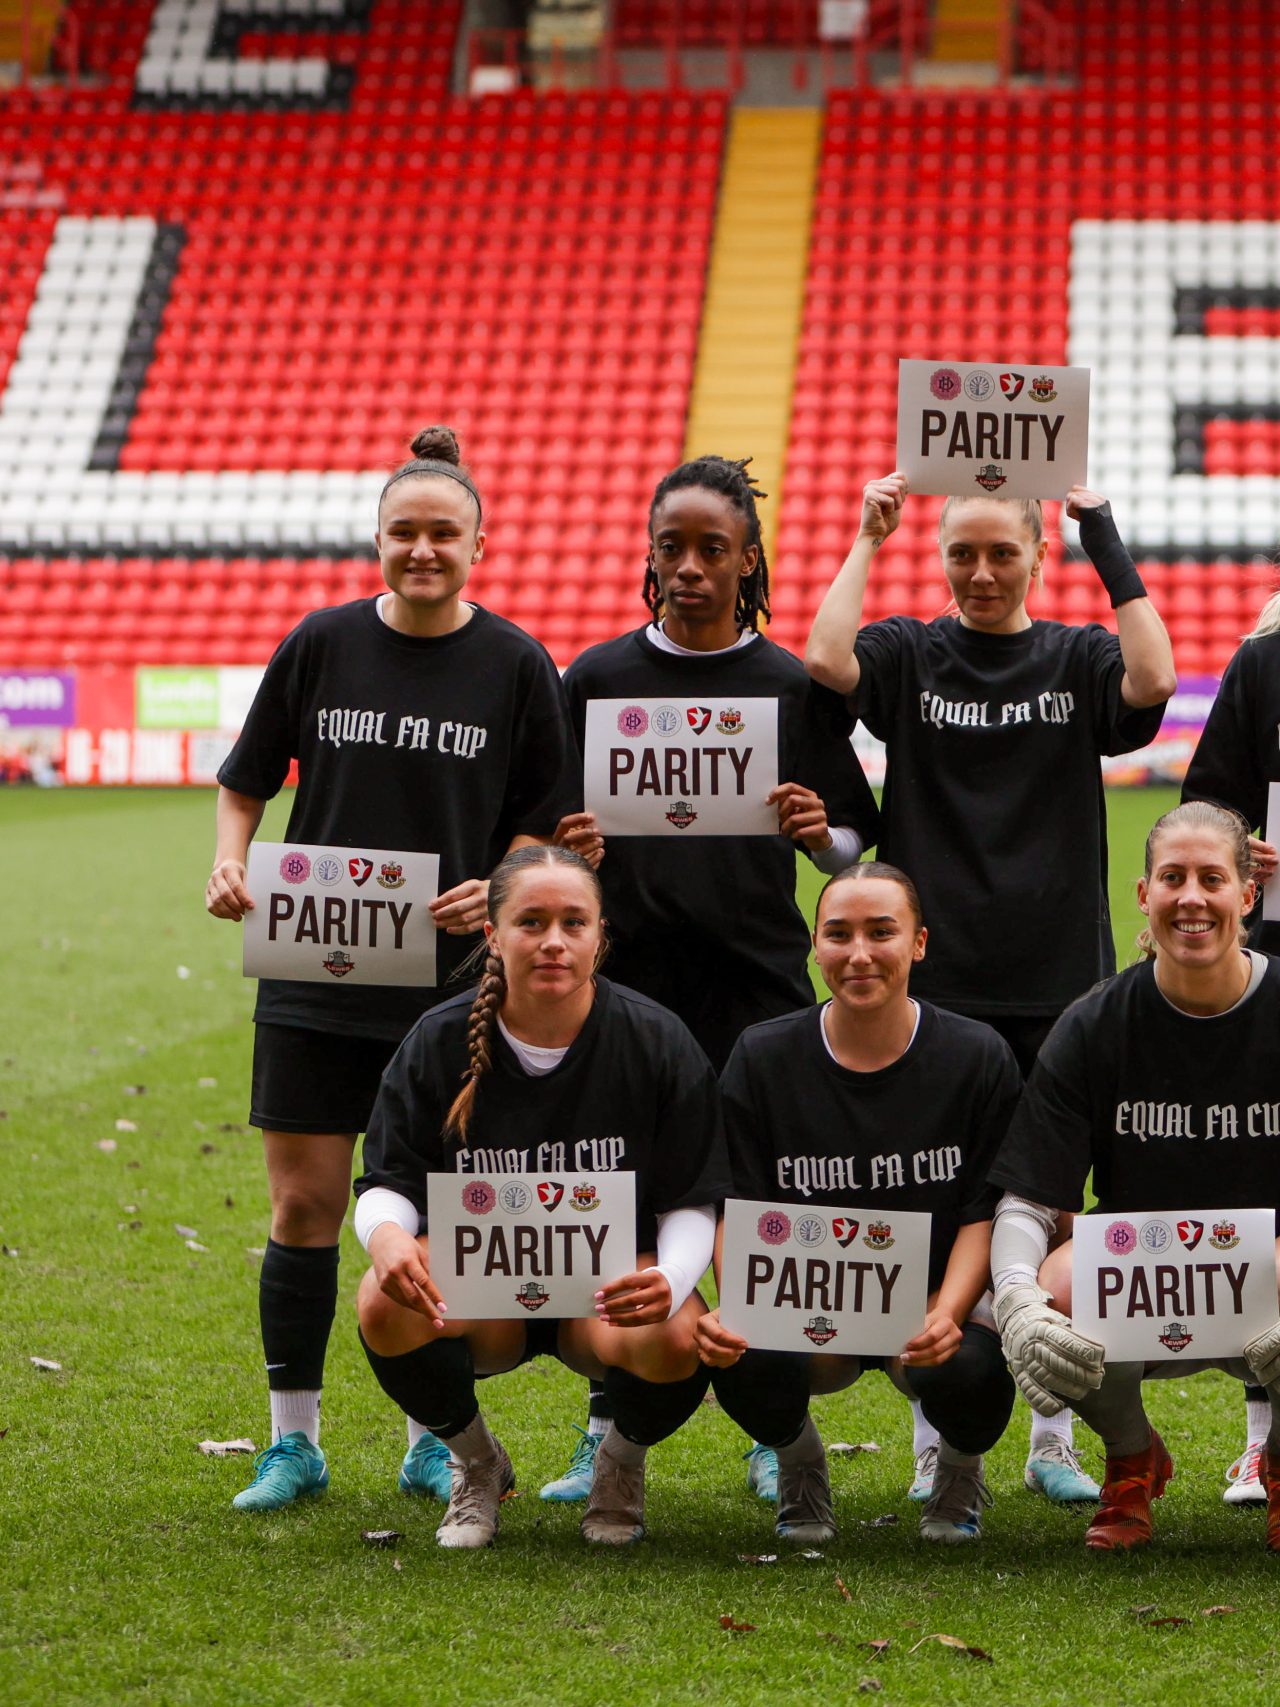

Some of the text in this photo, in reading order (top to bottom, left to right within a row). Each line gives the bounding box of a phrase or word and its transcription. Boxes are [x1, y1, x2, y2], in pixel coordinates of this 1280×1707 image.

[921, 409, 1065, 462] PARITY
[317, 708, 487, 759] EQUAL FA CUP
[920, 690, 1075, 729] EQUAL FA CUP
[610, 747, 753, 796] PARITY
[268, 892, 413, 949] PARITY
[1115, 1100, 1197, 1143] EQUAL
[1205, 1102, 1239, 1140] FA
[574, 1136, 626, 1172] CUP
[776, 1144, 963, 1197] EQUAL FA CUP
[455, 1224, 610, 1277] PARITY
[745, 1254, 902, 1314] PARITY
[1097, 1262, 1250, 1319] PARITY
